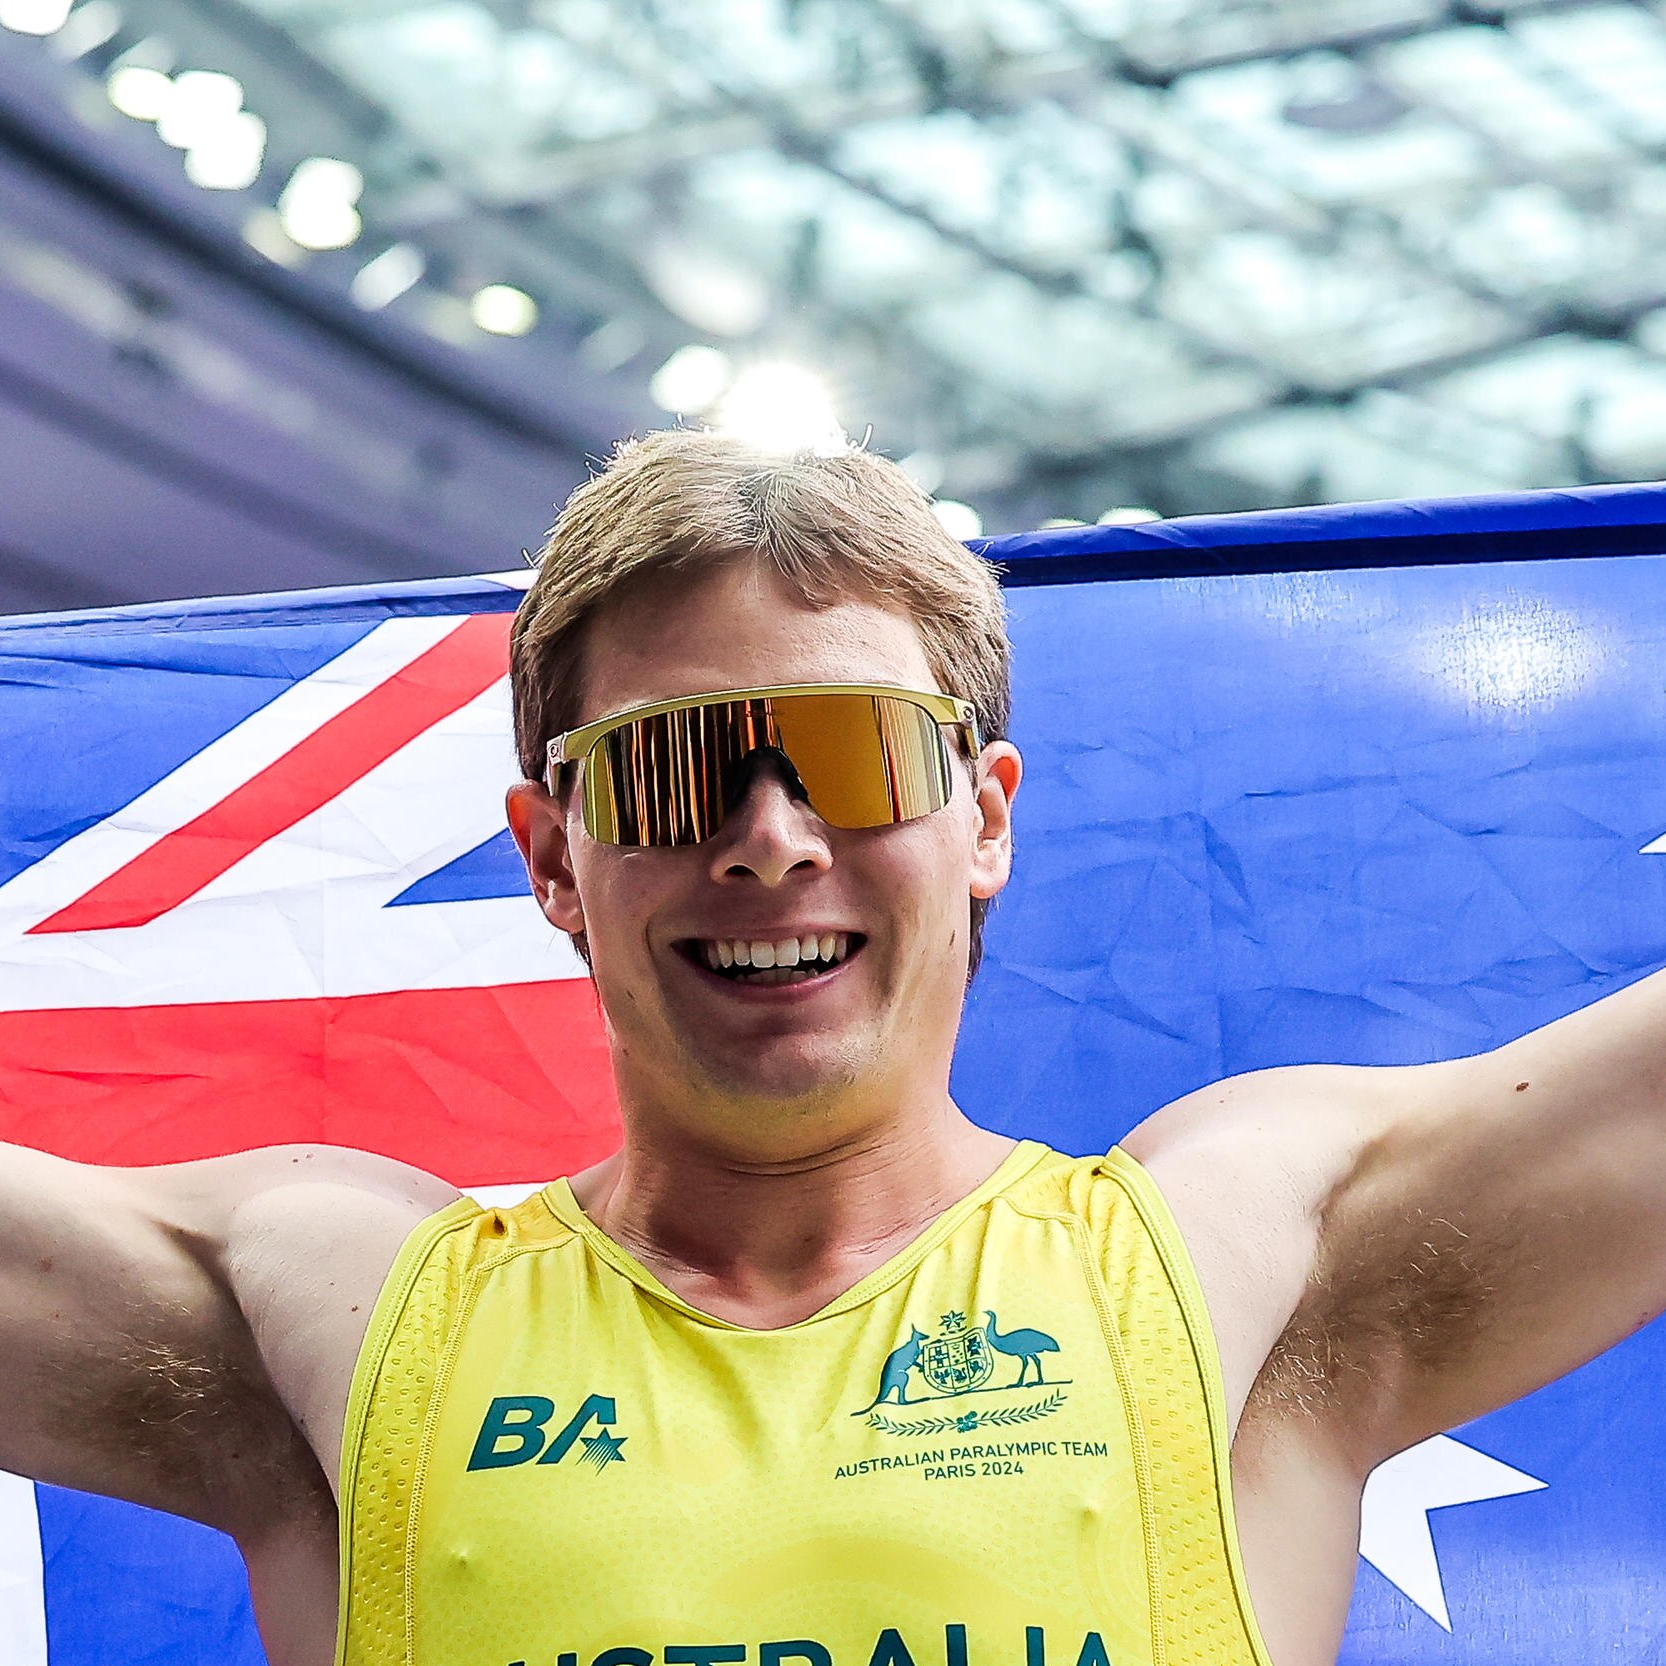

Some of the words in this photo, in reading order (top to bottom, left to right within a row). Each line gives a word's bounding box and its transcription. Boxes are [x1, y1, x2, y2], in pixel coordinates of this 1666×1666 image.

[834, 1449, 945, 1480] AUSTRALIAN
[950, 1441, 1057, 1459] PARALYMPIC
[1061, 1441, 1109, 1457] TEAM
[924, 1463, 976, 1481] PARIS
[982, 1461, 1024, 1476] 2024
